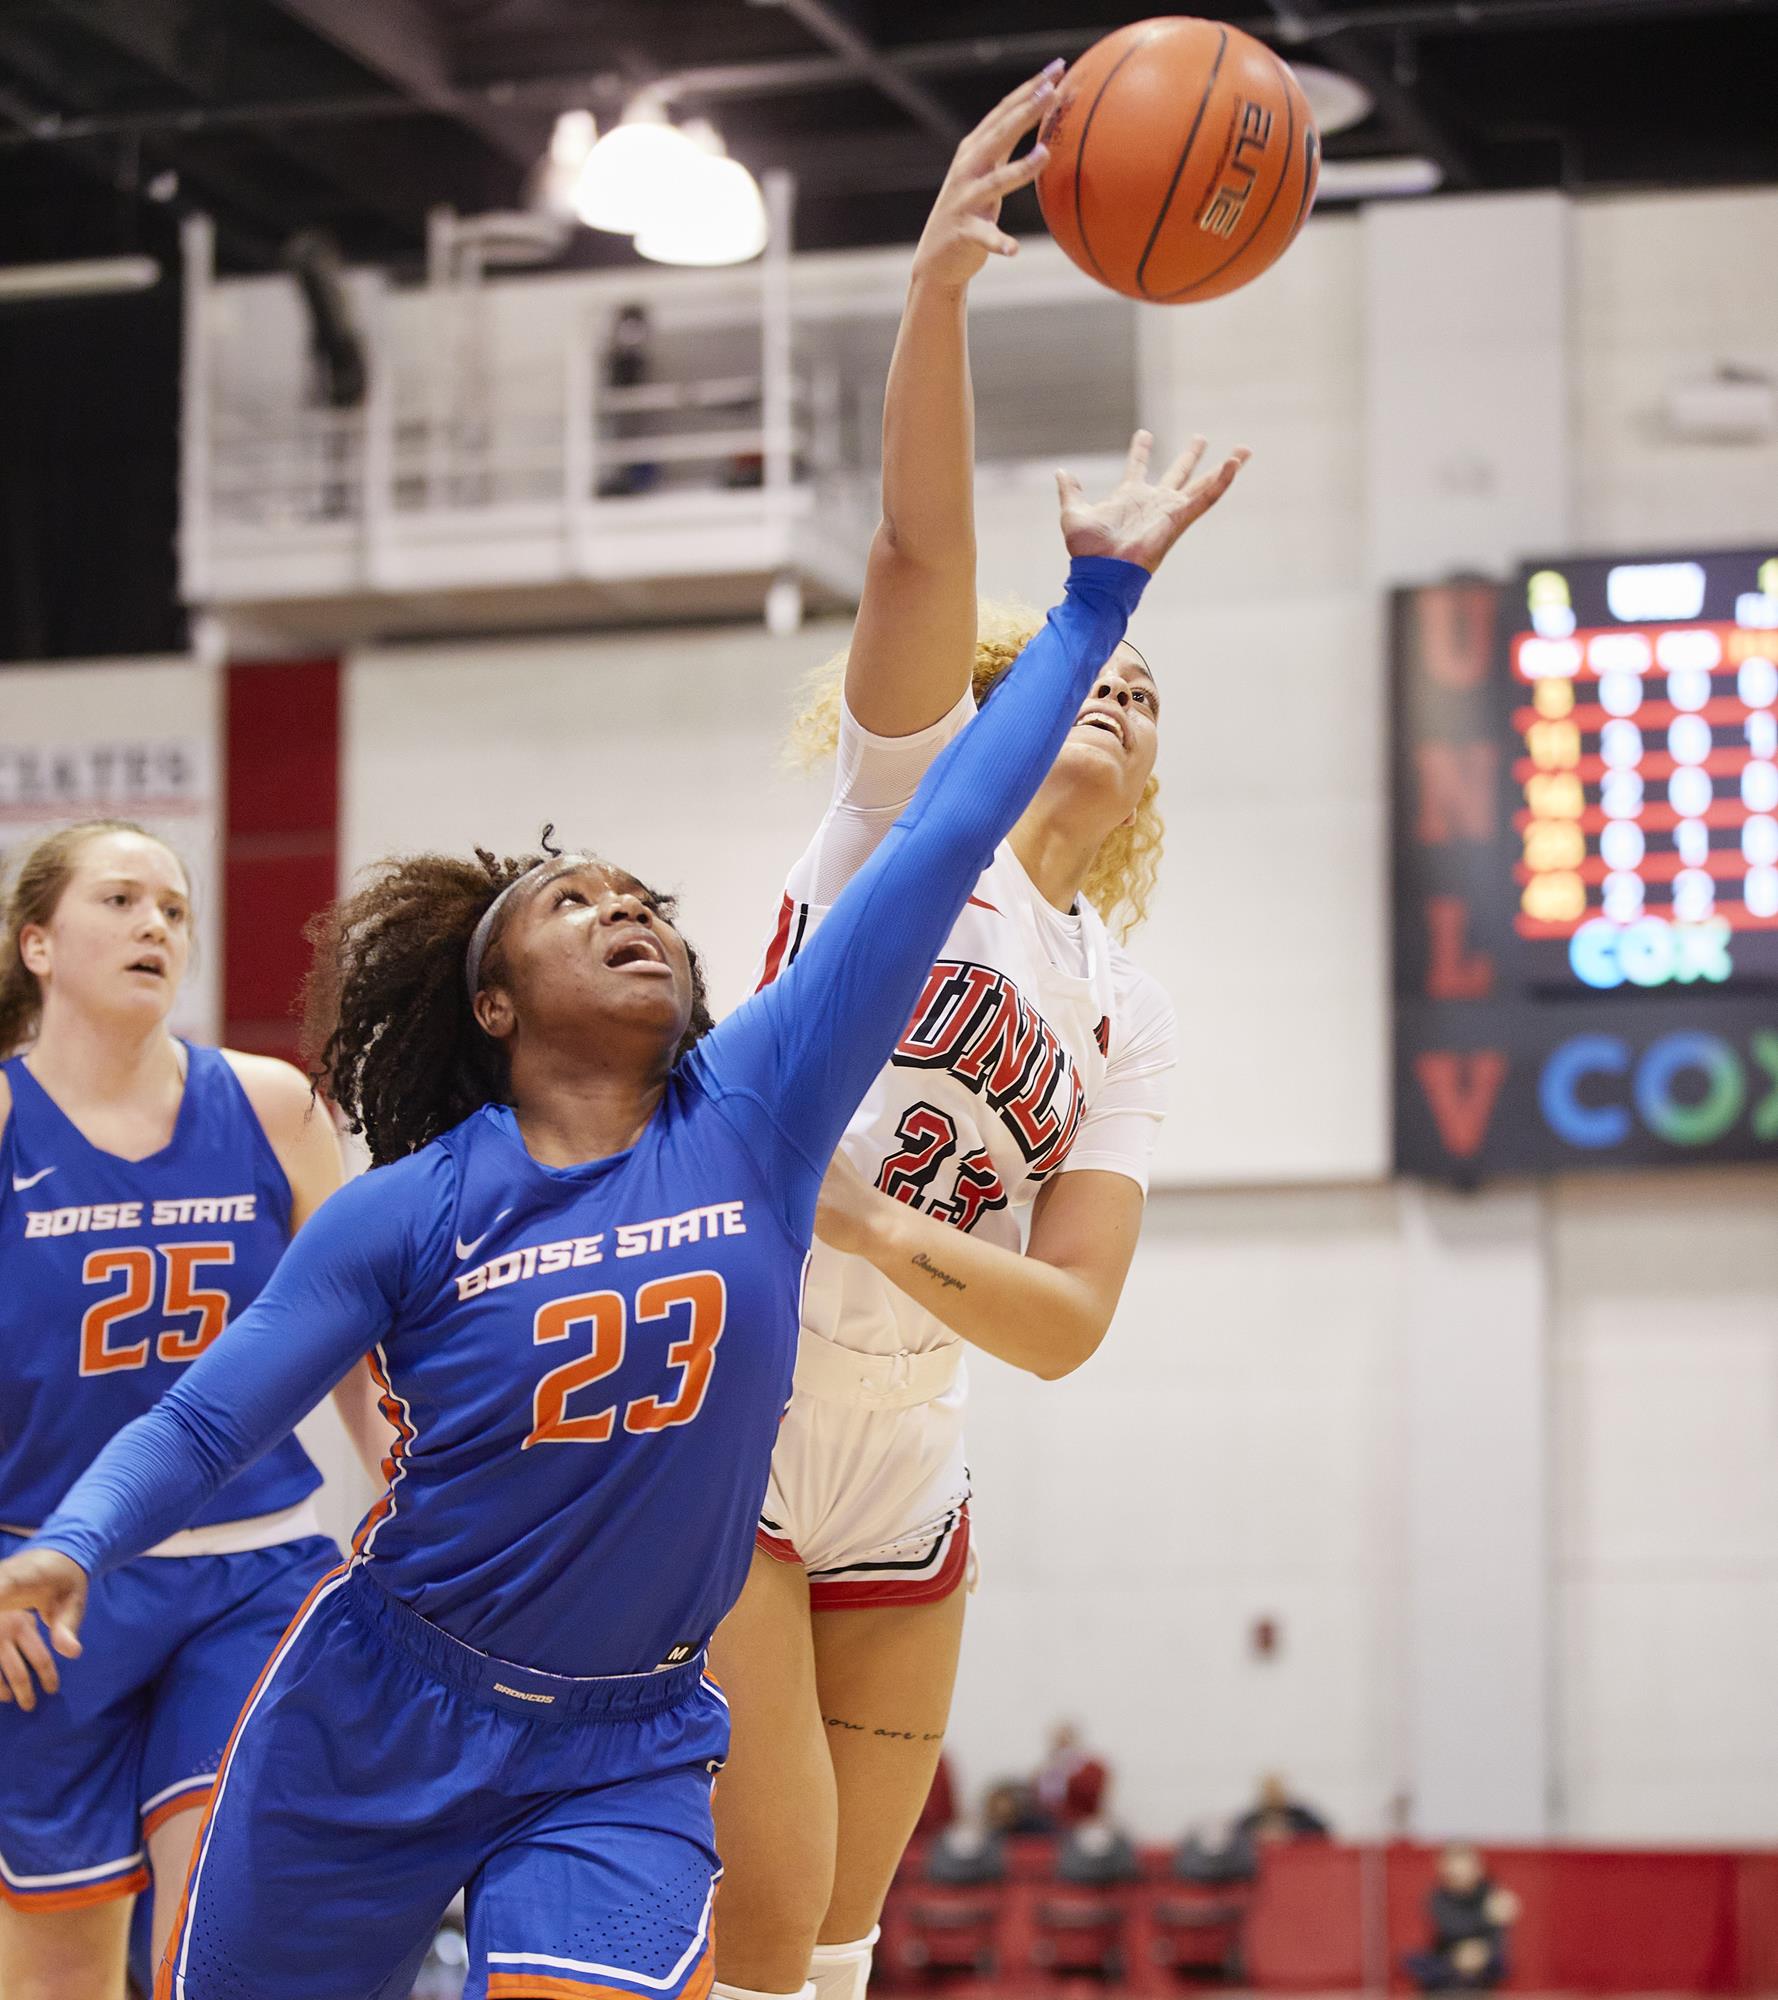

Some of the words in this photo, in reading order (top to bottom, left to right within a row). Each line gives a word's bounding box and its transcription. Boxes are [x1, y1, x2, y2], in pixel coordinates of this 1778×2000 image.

[1200, 102, 1273, 239] ELITE
[1568, 914, 1733, 989] COX
[25, 1202, 144, 1239] BOISE
[152, 1194, 257, 1226] STATE
[454, 1233, 604, 1301] BOISE
[614, 1200, 747, 1258] STATE
[79, 1240, 235, 1377] 25
[520, 1269, 727, 1451] 23
[667, 1646, 689, 1660] M
[493, 1682, 556, 1704] BRONCOS
[822, 1716, 865, 1731] ou
[873, 1728, 917, 1740] are
